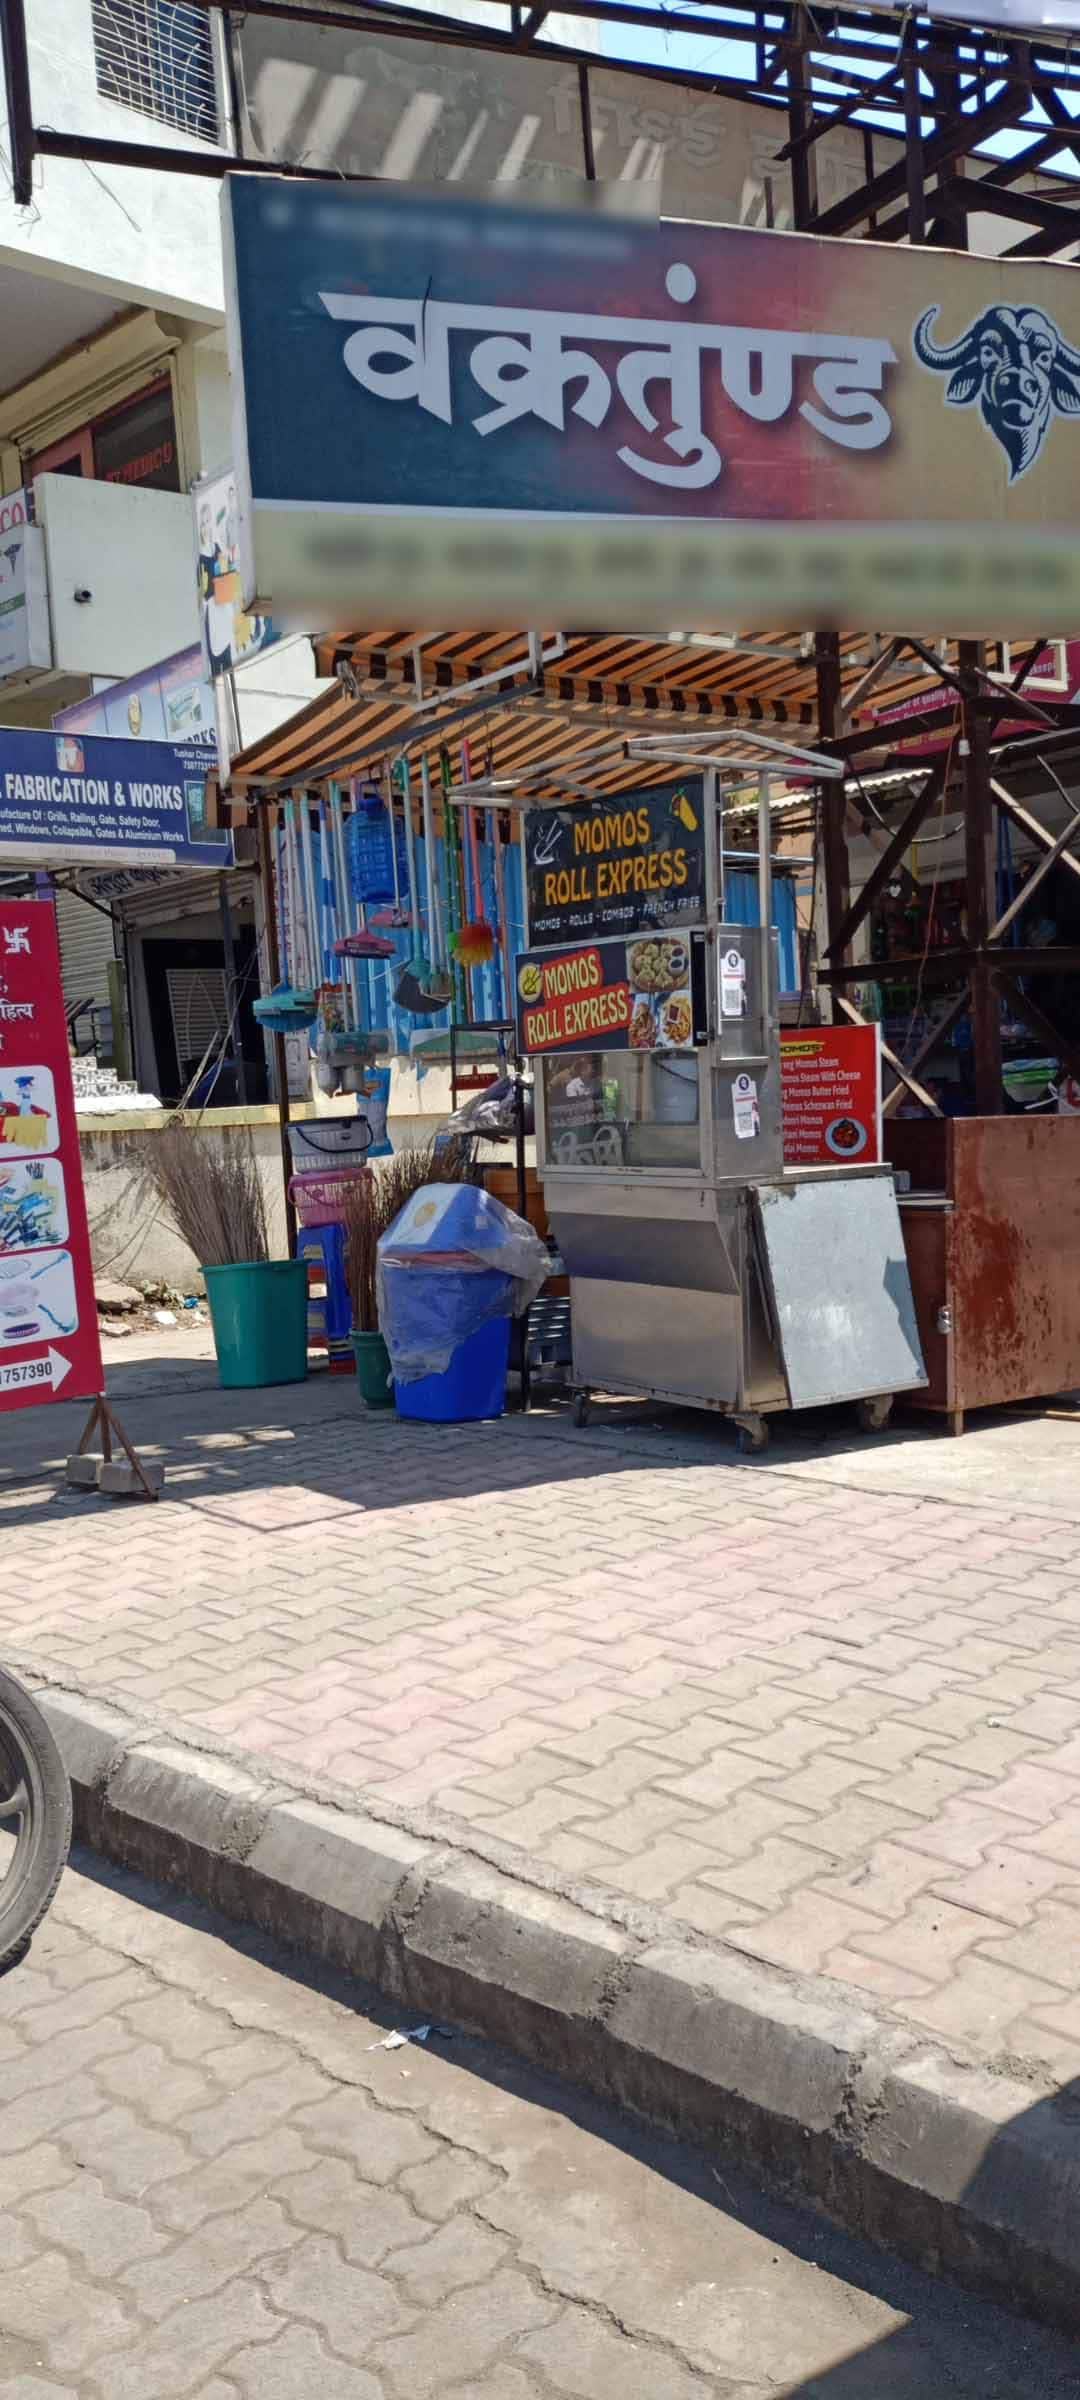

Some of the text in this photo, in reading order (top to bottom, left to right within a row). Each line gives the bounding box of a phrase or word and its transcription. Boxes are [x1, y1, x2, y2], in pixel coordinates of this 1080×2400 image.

[5, 773, 183, 811] FABRICATION & WORKS
[119, 815, 140, 829] Safety
[574, 807, 650, 856] MOMOS
[545, 848, 688, 906] ROLL EXPRESS
[534, 917, 561, 931] MOMOS
[569, 912, 593, 927] ROLLS
[602, 906, 635, 922] COMBOS
[643, 899, 674, 917] FRENCH
[677, 896, 701, 911] FRIES
[543, 954, 599, 999] MOMOS
[527, 989, 628, 1046] ROLL EXPRESS
[821, 1070, 837, 1081] With
[837, 1069, 861, 1081] Cheese
[832, 1084, 849, 1096] Fried
[836, 1098, 853, 1110] Fried
